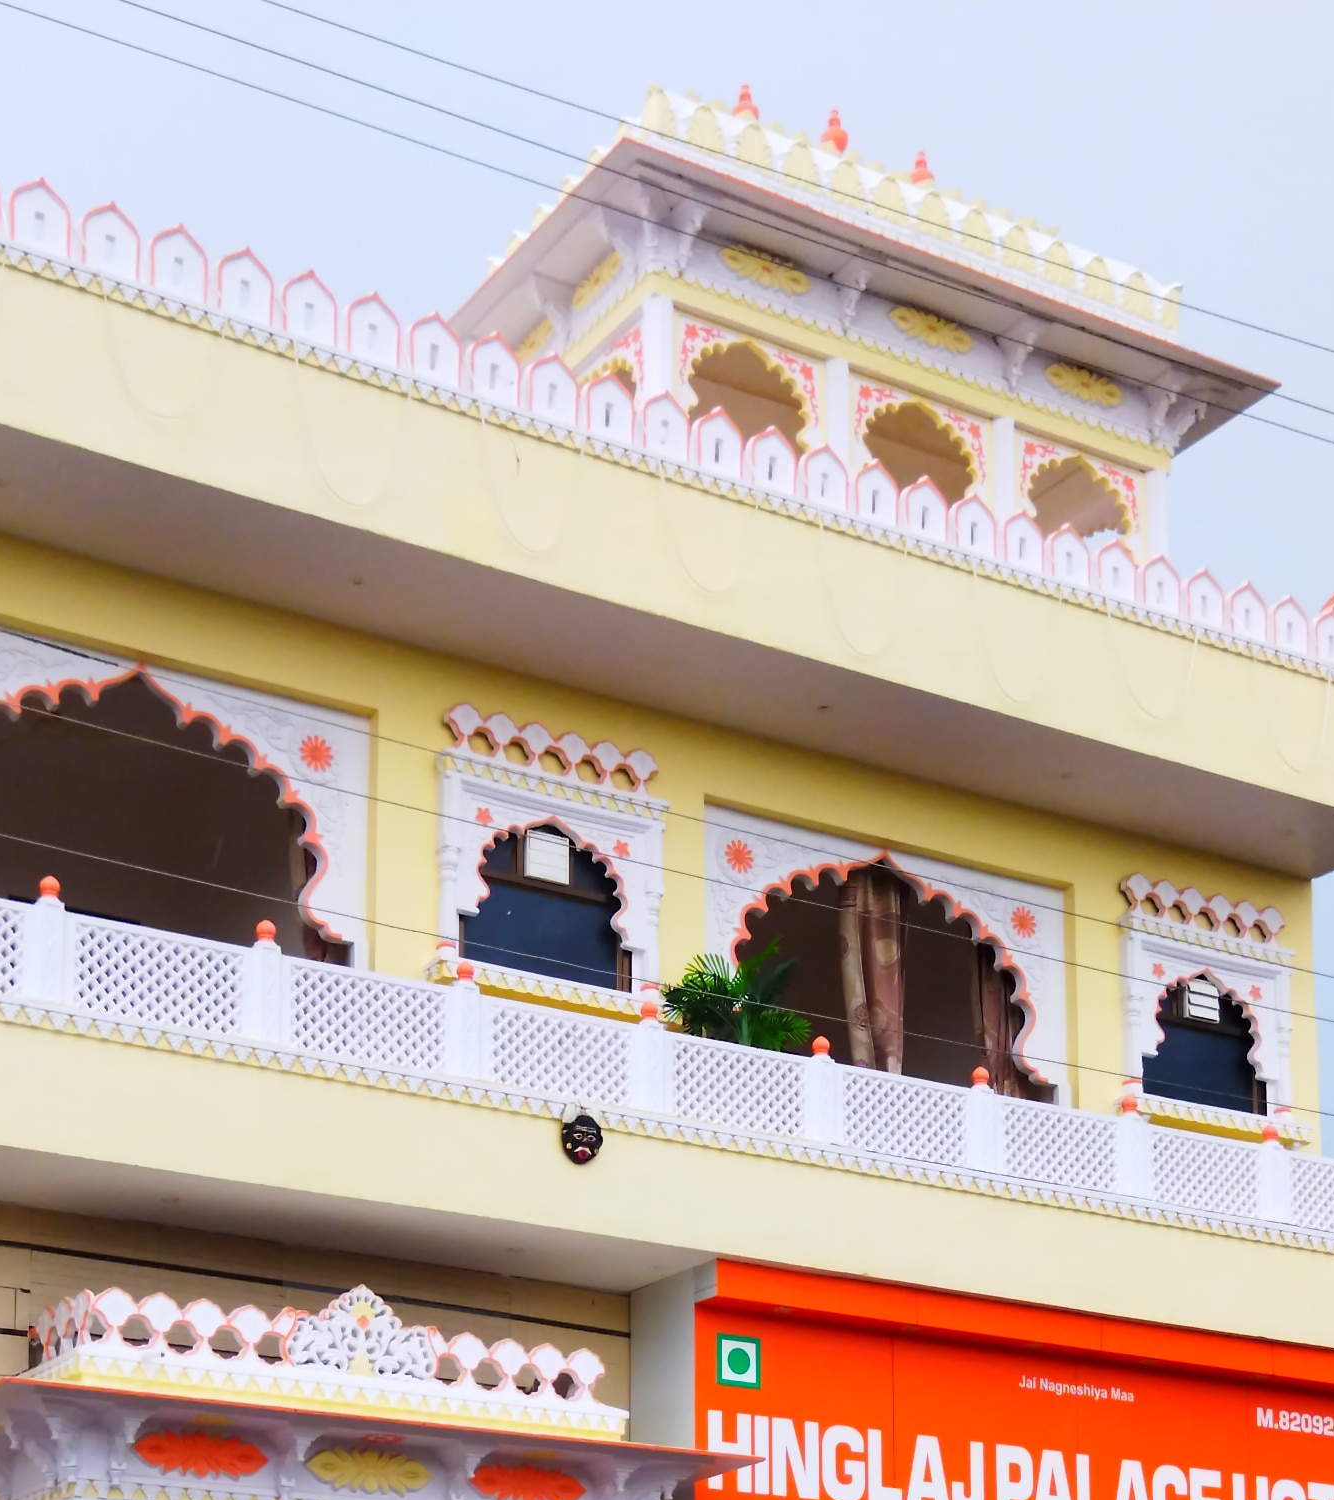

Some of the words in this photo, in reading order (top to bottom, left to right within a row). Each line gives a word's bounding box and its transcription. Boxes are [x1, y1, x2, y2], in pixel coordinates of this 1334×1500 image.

[1019, 1375, 1037, 1390] Jai
[1039, 1378, 1108, 1401] Nagneshiya
[1110, 1386, 1135, 1403] Maa
